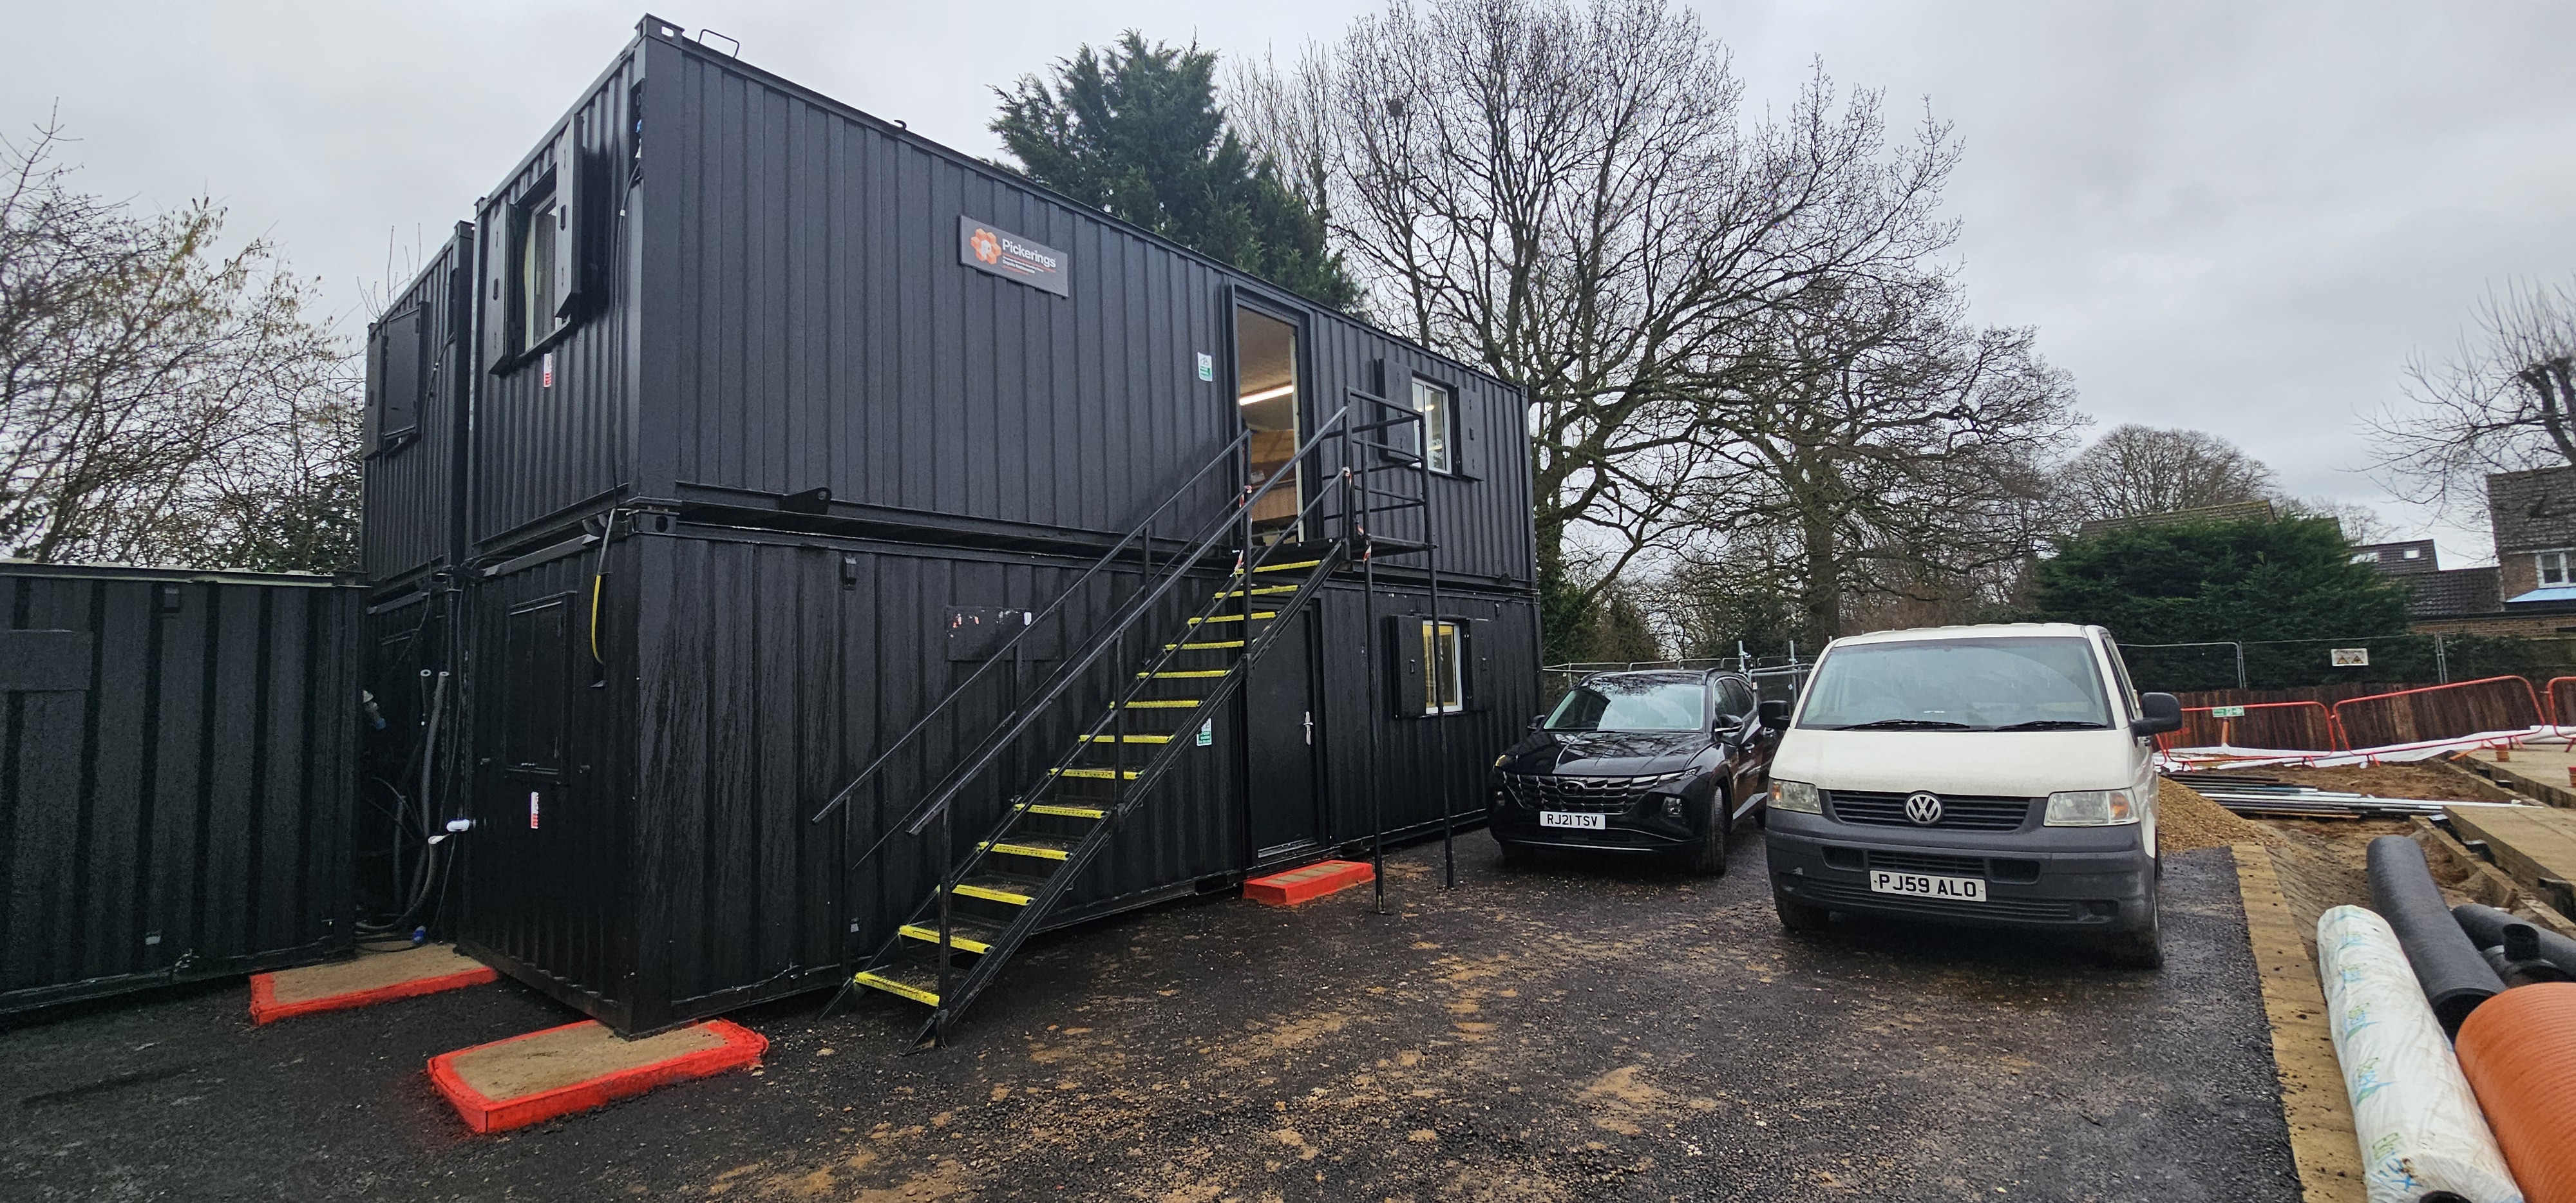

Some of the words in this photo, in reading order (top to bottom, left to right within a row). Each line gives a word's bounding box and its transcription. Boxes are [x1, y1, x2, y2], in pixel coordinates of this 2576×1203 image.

[1002, 238, 1056, 268] Pickerings
[1547, 814, 1573, 826] RJ21
[1575, 815, 1598, 827] TSV
[1879, 873, 1930, 893] PJ59
[1937, 879, 1977, 897] ALO
